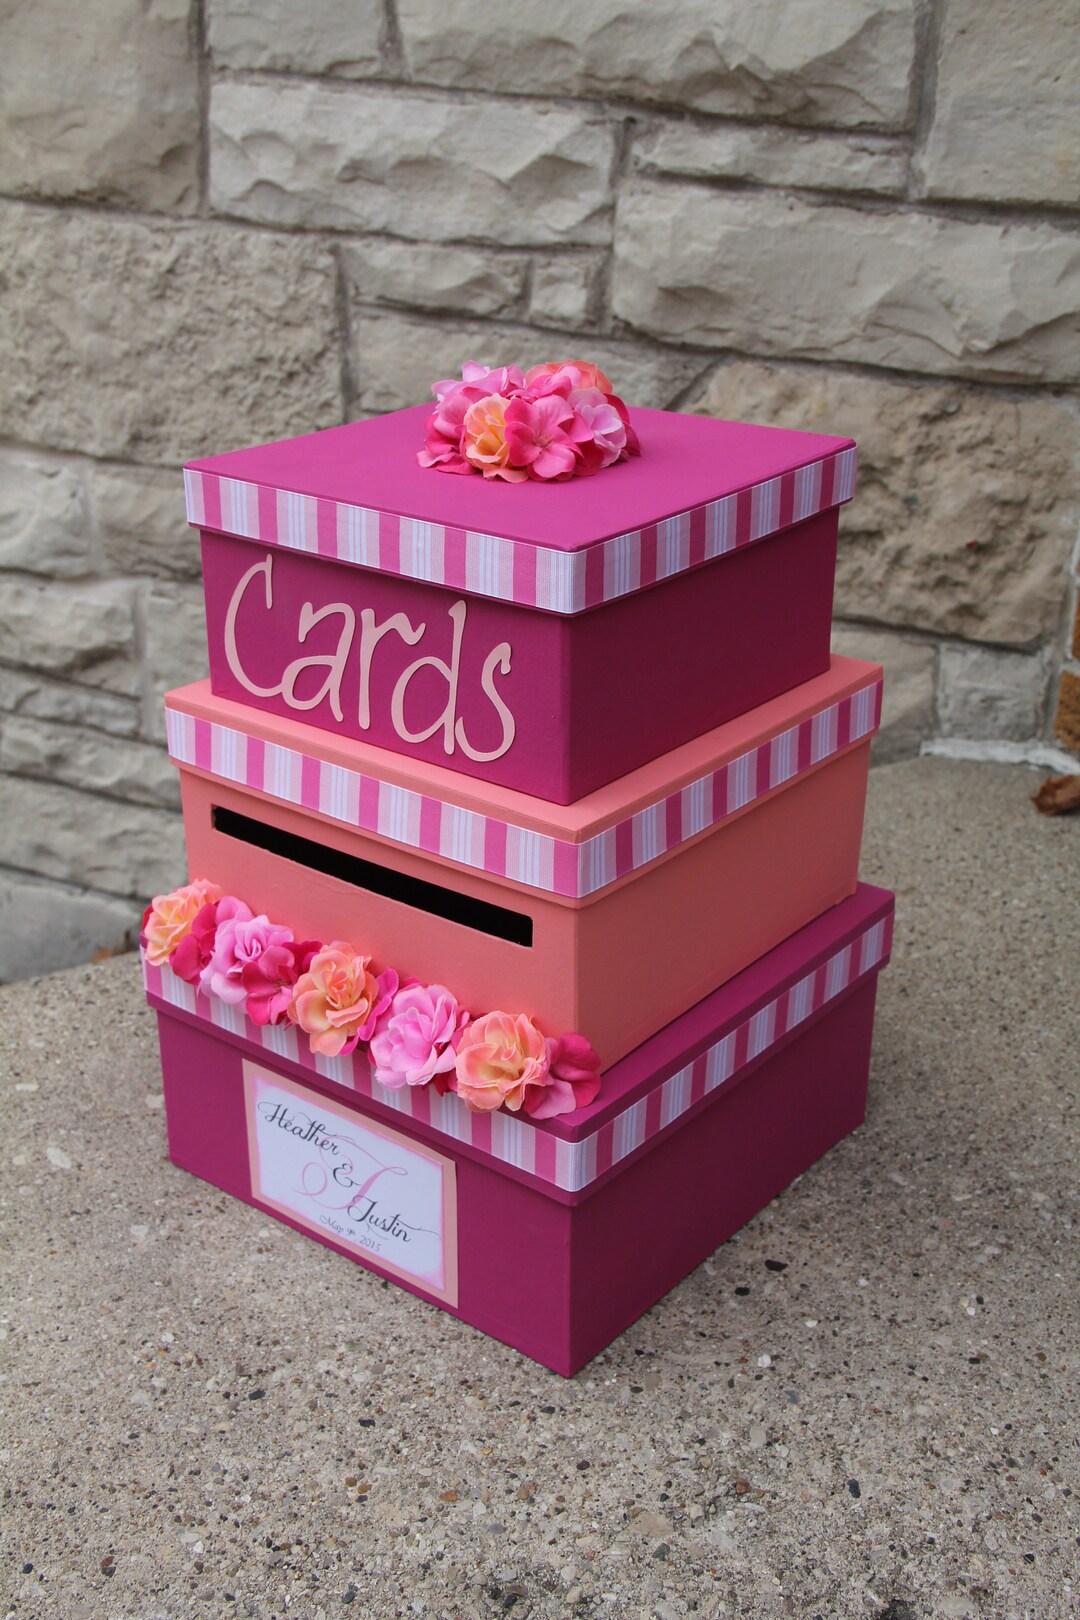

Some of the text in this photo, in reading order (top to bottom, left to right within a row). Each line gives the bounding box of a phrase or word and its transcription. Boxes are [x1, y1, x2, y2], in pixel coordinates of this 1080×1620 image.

[224, 553, 516, 762] Cards
[258, 1102, 353, 1155] Heather
[333, 1163, 361, 1187] &
[320, 1215, 344, 1233] May
[360, 1235, 381, 1251] 2015
[347, 1195, 438, 1243] Justin
